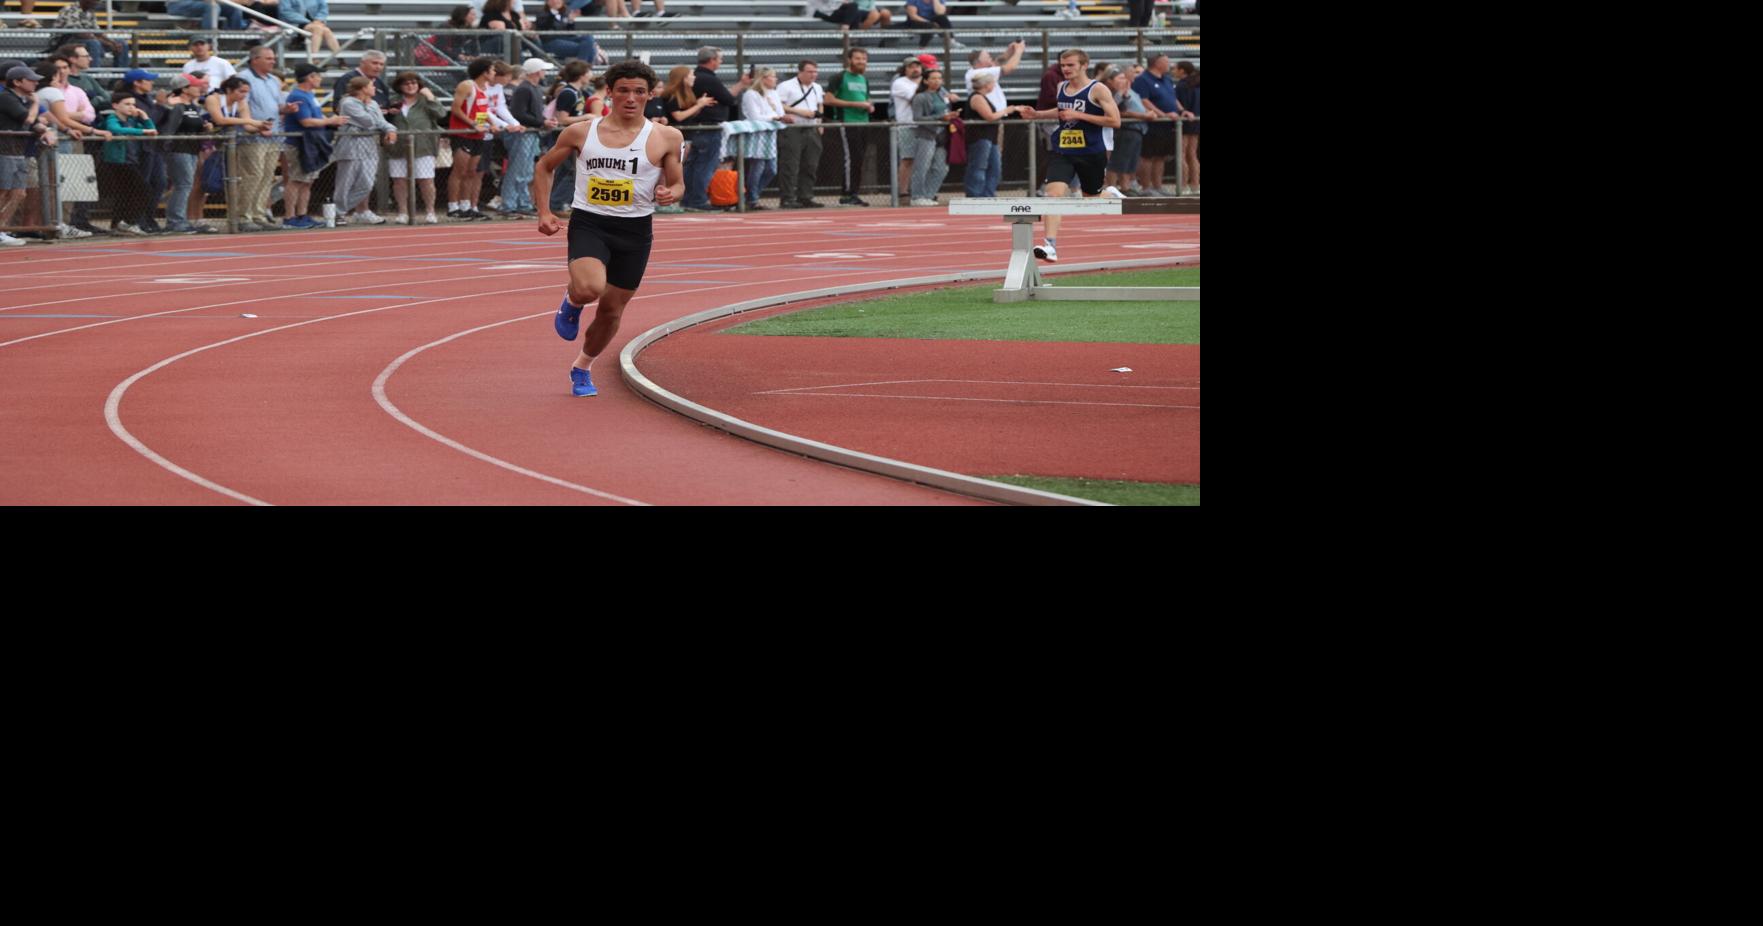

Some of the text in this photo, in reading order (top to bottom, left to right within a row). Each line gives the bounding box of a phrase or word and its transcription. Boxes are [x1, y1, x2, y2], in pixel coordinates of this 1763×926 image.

[1075, 101, 1083, 111] 2
[1062, 136, 1083, 145] 2344
[629, 157, 638, 174] 1
[591, 187, 629, 201] 2591
